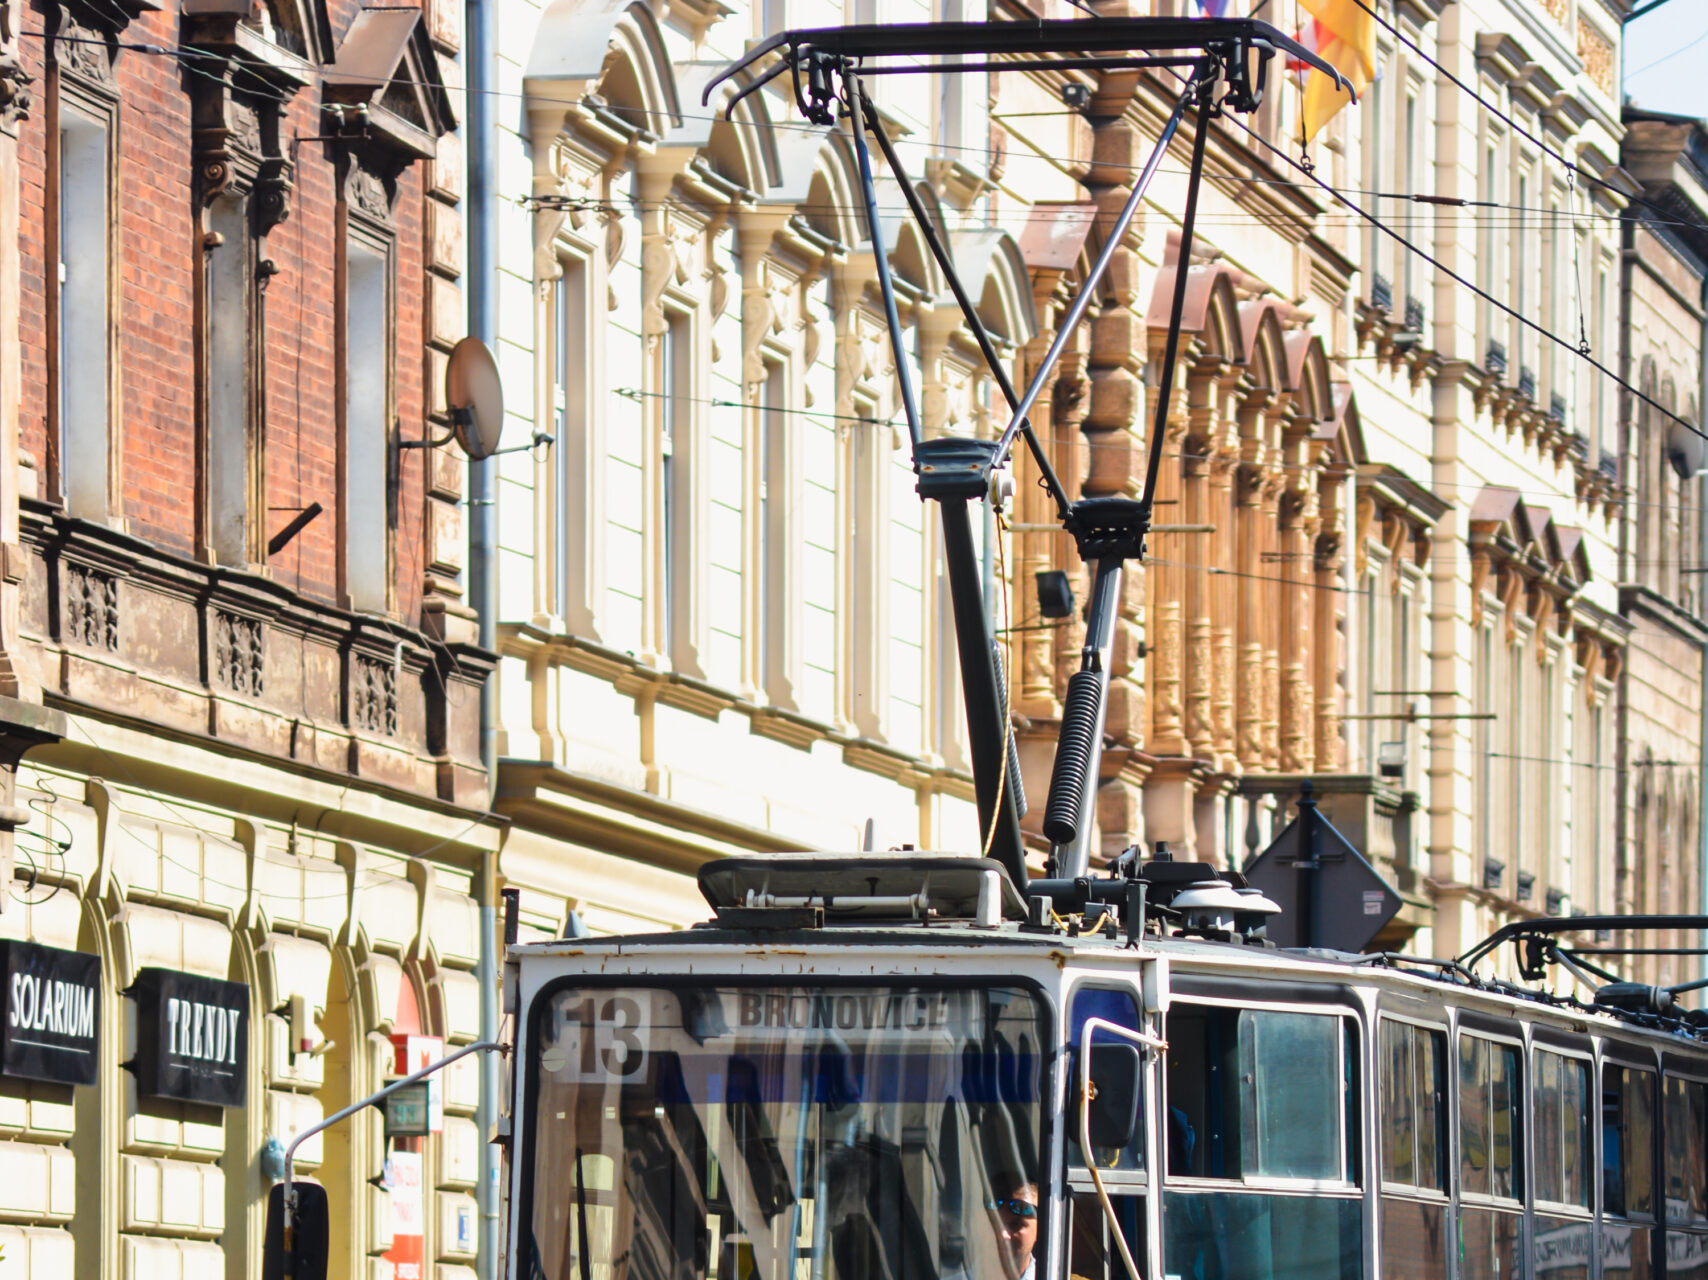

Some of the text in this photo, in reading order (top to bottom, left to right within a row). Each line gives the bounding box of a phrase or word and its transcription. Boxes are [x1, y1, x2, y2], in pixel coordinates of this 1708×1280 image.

[10, 972, 94, 1038] SOLARIUM
[168, 998, 240, 1064] TRENDY
[566, 997, 643, 1077] 13
[740, 993, 948, 1031] BRONOWICE
